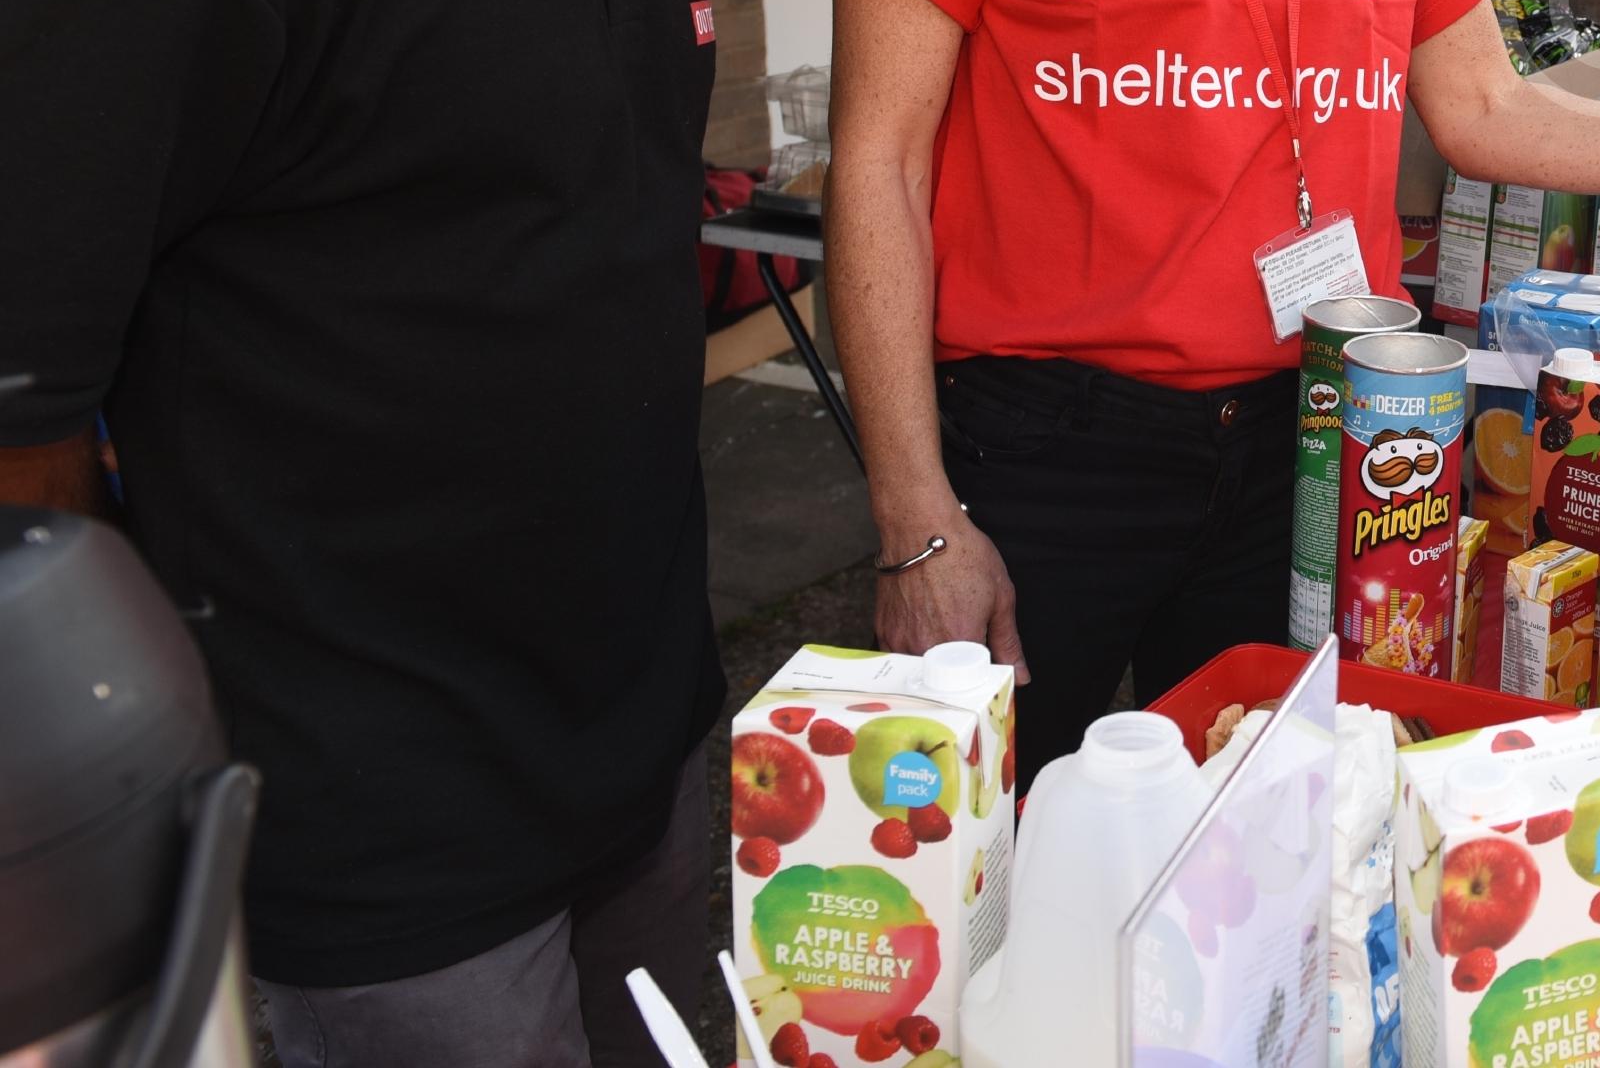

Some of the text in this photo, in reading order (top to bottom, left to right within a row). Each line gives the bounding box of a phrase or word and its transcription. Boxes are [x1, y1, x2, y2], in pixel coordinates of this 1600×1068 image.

[1034, 49, 1402, 124] shelter.org.uk
[1286, 246, 1302, 258] PLEASE
[1376, 394, 1425, 416] DEEZER
[1429, 392, 1454, 406] FREE
[1354, 490, 1451, 556] Pringles
[1564, 501, 1600, 522] JUICE
[1409, 533, 1454, 566] Original
[1530, 621, 1546, 633] Juice
[890, 764, 937, 786] Family
[897, 783, 929, 797] pack
[807, 891, 880, 914] TESCO
[793, 924, 895, 957] APPLE &
[775, 943, 913, 980] RASPBERRY
[793, 971, 892, 994] JUICE DRINK
[1522, 973, 1597, 1004] TESCO
[1510, 1009, 1589, 1050] APPLE
